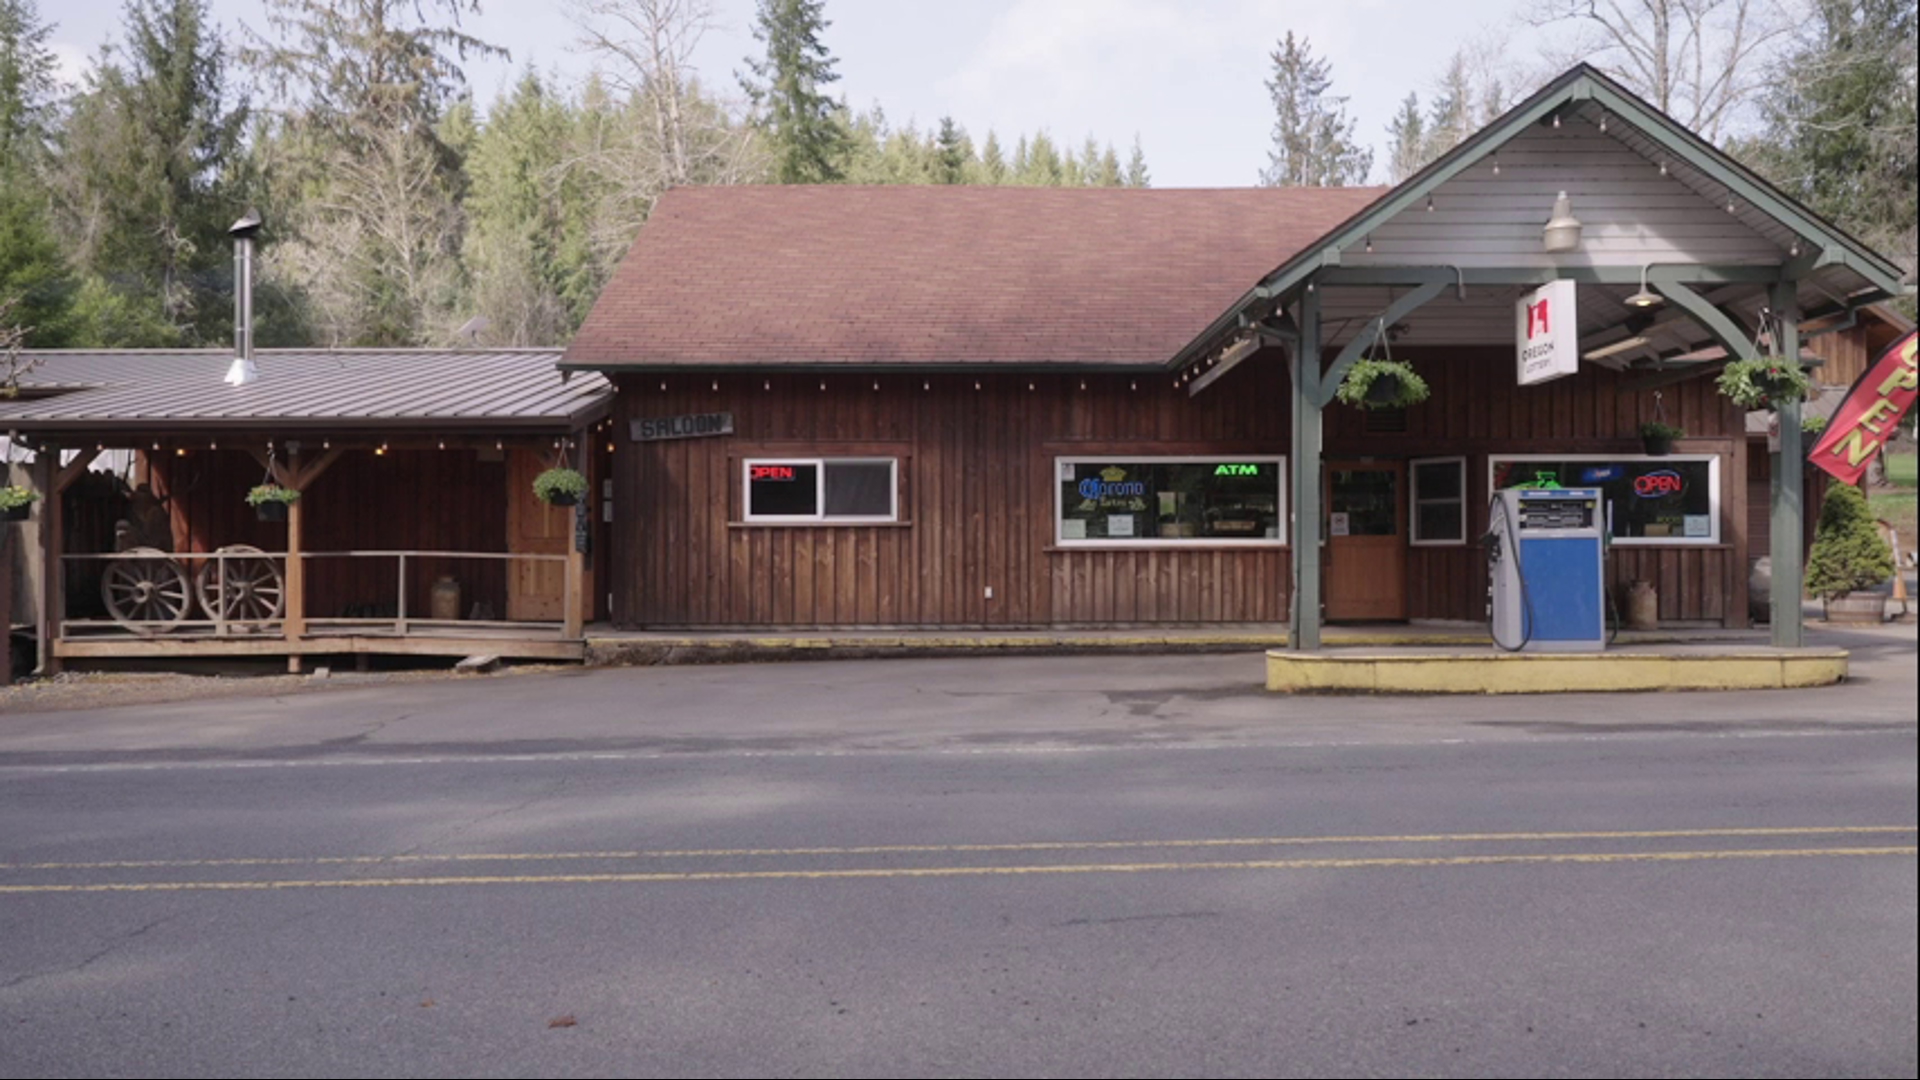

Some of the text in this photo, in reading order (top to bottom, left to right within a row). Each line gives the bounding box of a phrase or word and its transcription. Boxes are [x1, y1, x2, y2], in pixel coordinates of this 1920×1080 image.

[641, 414, 722, 438] SALOON
[750, 467, 793, 478] OPEN
[1214, 464, 1258, 475] ATM
[1079, 478, 1144, 499] Corona
[1634, 475, 1682, 492] OPEN
